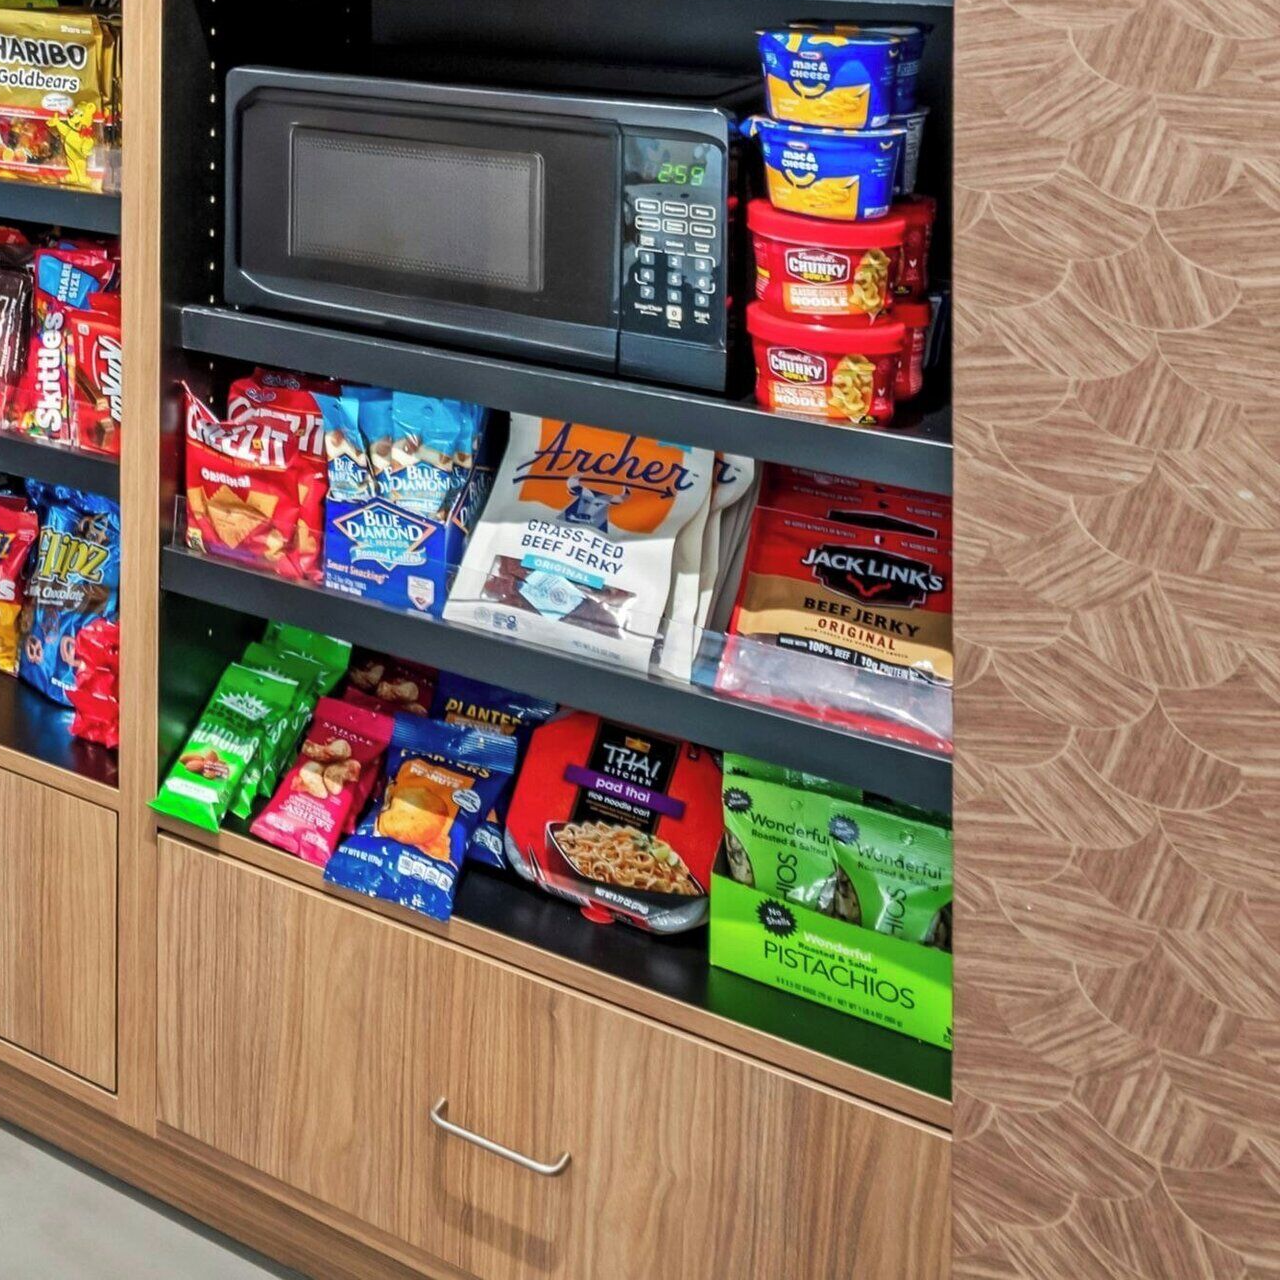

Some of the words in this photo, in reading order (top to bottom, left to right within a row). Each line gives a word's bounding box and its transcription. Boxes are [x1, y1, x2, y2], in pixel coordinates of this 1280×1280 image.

[792, 59, 818, 71] mac
[782, 150, 806, 161] mac
[789, 258, 846, 278] CHUNKY
[57, 263, 73, 303] SHARE
[69, 272, 81, 299] SIZE
[771, 355, 822, 379] CHUNKY
[516, 422, 695, 492] Archer
[392, 476, 452, 492] DIAMOND
[407, 465, 441, 480] BLUE
[347, 520, 424, 544] DIAMOND
[363, 511, 400, 528] BLUE
[527, 518, 624, 559] GRASS-FED
[521, 533, 563, 551] BEEF
[566, 544, 623, 576] JERKY
[801, 548, 865, 576] JACK
[533, 558, 591, 582] ORIGINAL
[804, 596, 851, 617] BEEF
[852, 606, 920, 638] JERKY
[817, 618, 896, 651] ORIGINAL
[808, 639, 833, 656] 100%
[834, 648, 851, 661] BEEF
[602, 742, 662, 778] THAI
[603, 766, 653, 787] KITCHEN
[595, 777, 623, 795] pad
[625, 784, 651, 804] thai
[603, 795, 633, 813] noodle
[750, 810, 831, 847] Wonderful
[751, 828, 786, 844] Roasted
[798, 841, 829, 857] Salted
[857, 844, 943, 880] Wonderful
[766, 913, 791, 927] Shells
[767, 906, 782, 917] No
[798, 941, 836, 961] Roasted
[848, 957, 878, 975] Salted
[803, 930, 873, 963] Wonderful
[764, 940, 916, 1010] PISTACHIOS
